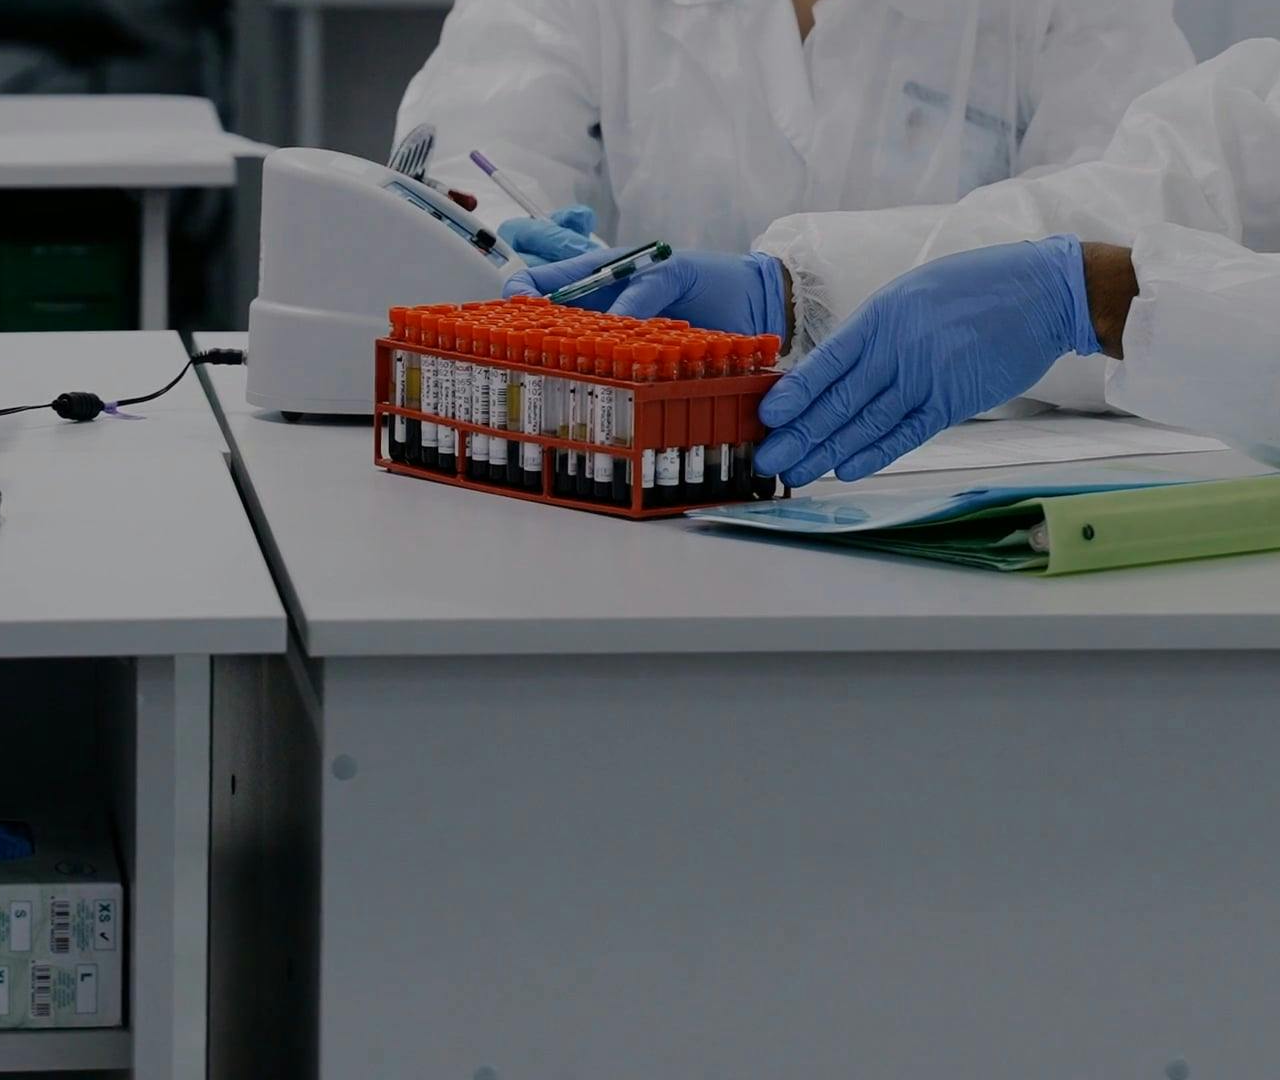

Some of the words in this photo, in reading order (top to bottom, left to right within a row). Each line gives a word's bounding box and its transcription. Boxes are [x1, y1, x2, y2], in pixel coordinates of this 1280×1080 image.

[15, 909, 26, 918] S
[98, 903, 111, 923] XS
[80, 972, 93, 982] L
